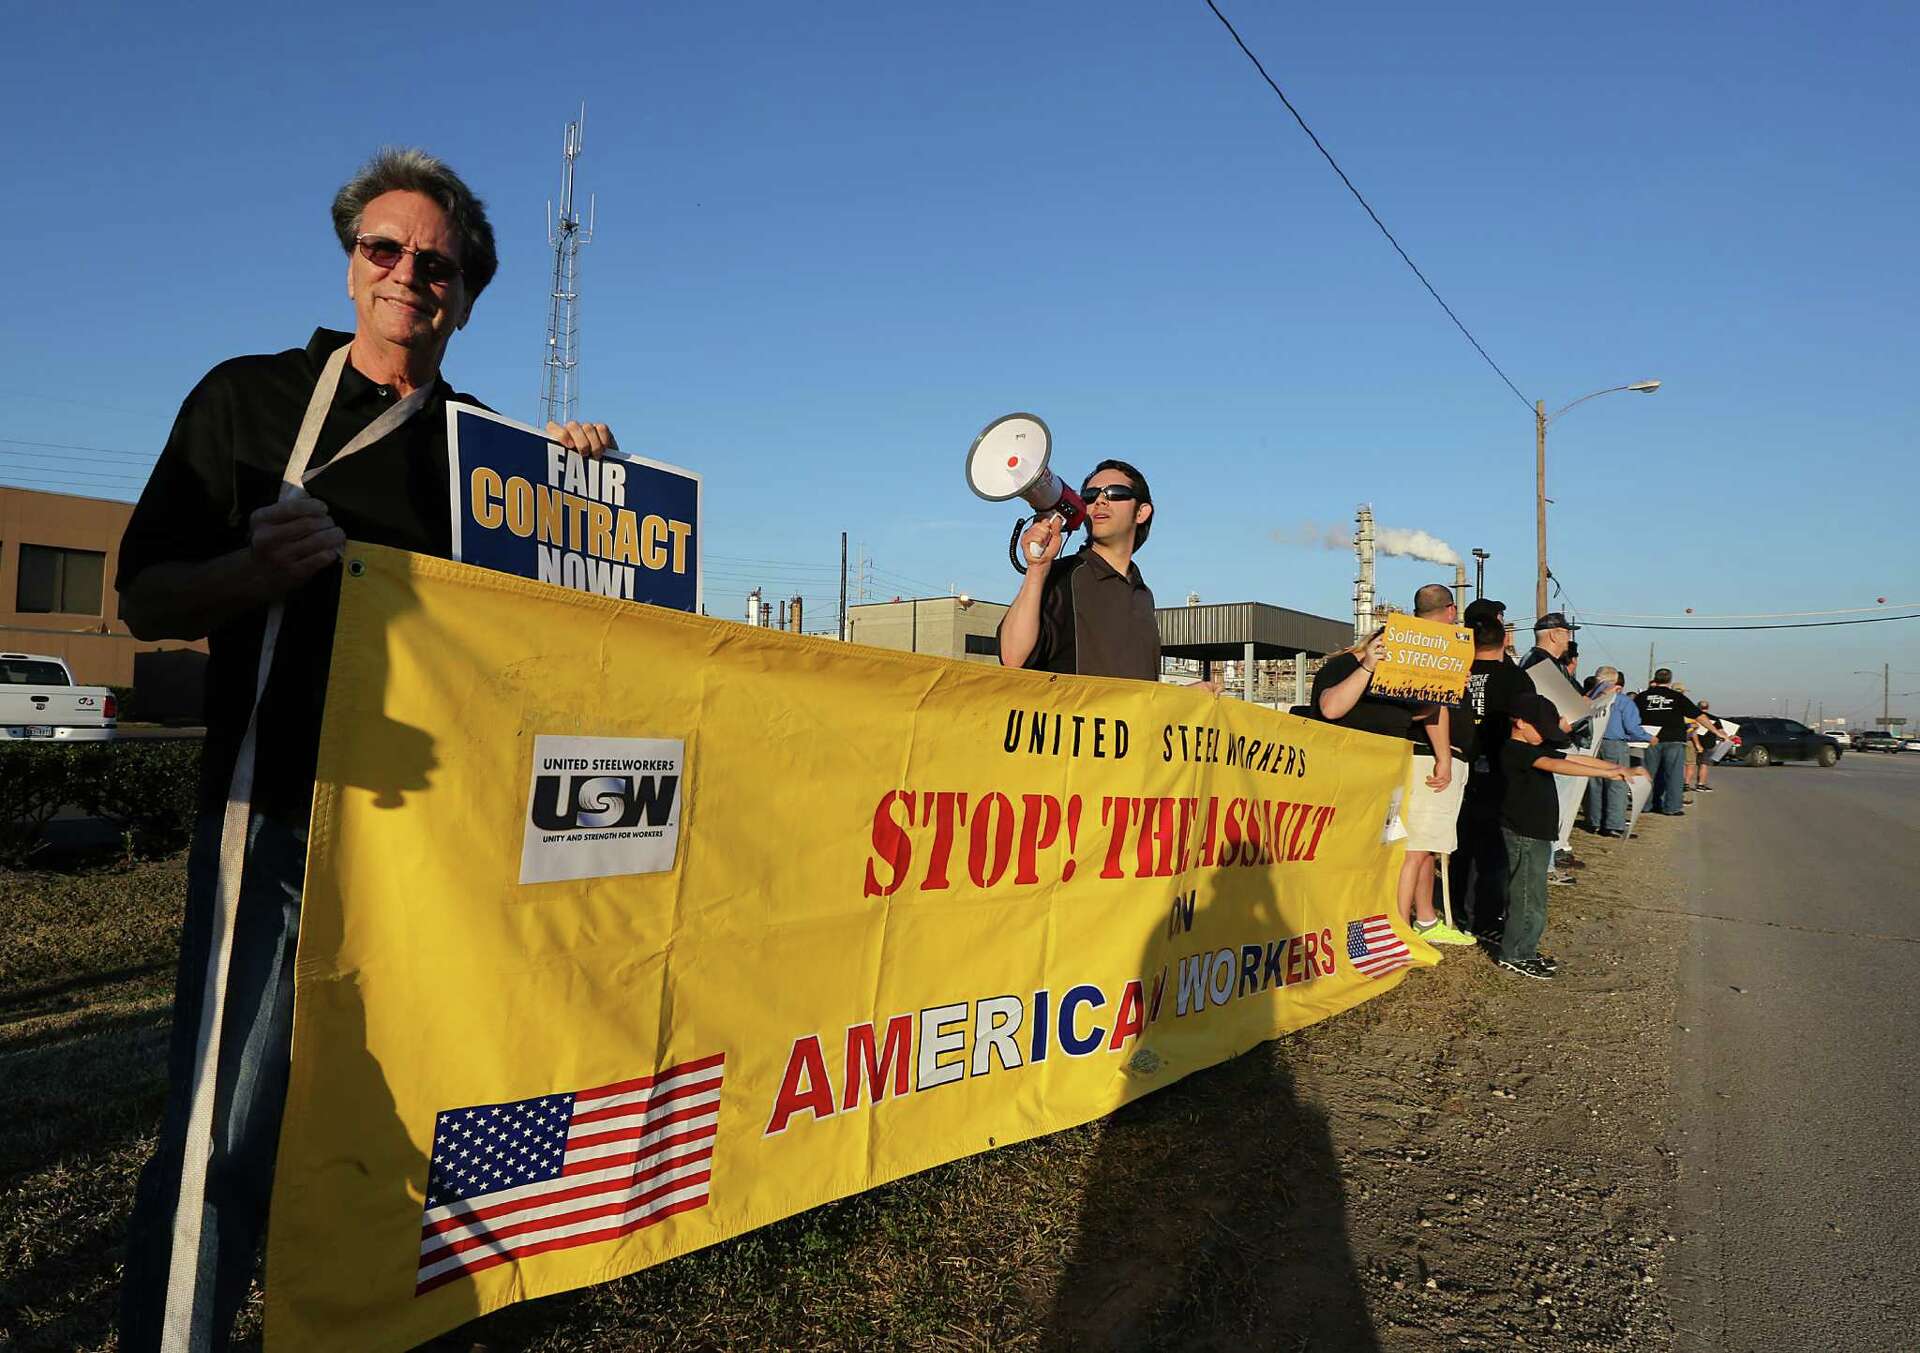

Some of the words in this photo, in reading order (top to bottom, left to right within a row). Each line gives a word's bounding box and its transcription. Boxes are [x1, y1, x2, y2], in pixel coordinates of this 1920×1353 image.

[547, 442, 626, 507] FAIR
[470, 466, 692, 574] CONTRACT
[538, 544, 635, 600] NOW!
[1387, 627, 1450, 653] Solidarity
[1003, 709, 1130, 759] UNITED
[543, 758, 589, 770] UNITED
[592, 758, 675, 771] STEELWORKERS
[532, 775, 679, 831] USW
[543, 834, 565, 843] UNITY
[567, 833, 583, 842] AND
[584, 831, 618, 841] STRENGTH
[618, 831, 631, 840] FOR
[632, 830, 664, 839] WORKERS
[863, 789, 1082, 898] STOP!
[1099, 796, 1200, 880] THE
[1194, 796, 1336, 868] ASSAULT
[1168, 890, 1196, 941] ON
[1175, 927, 1337, 1018] WORKERS
